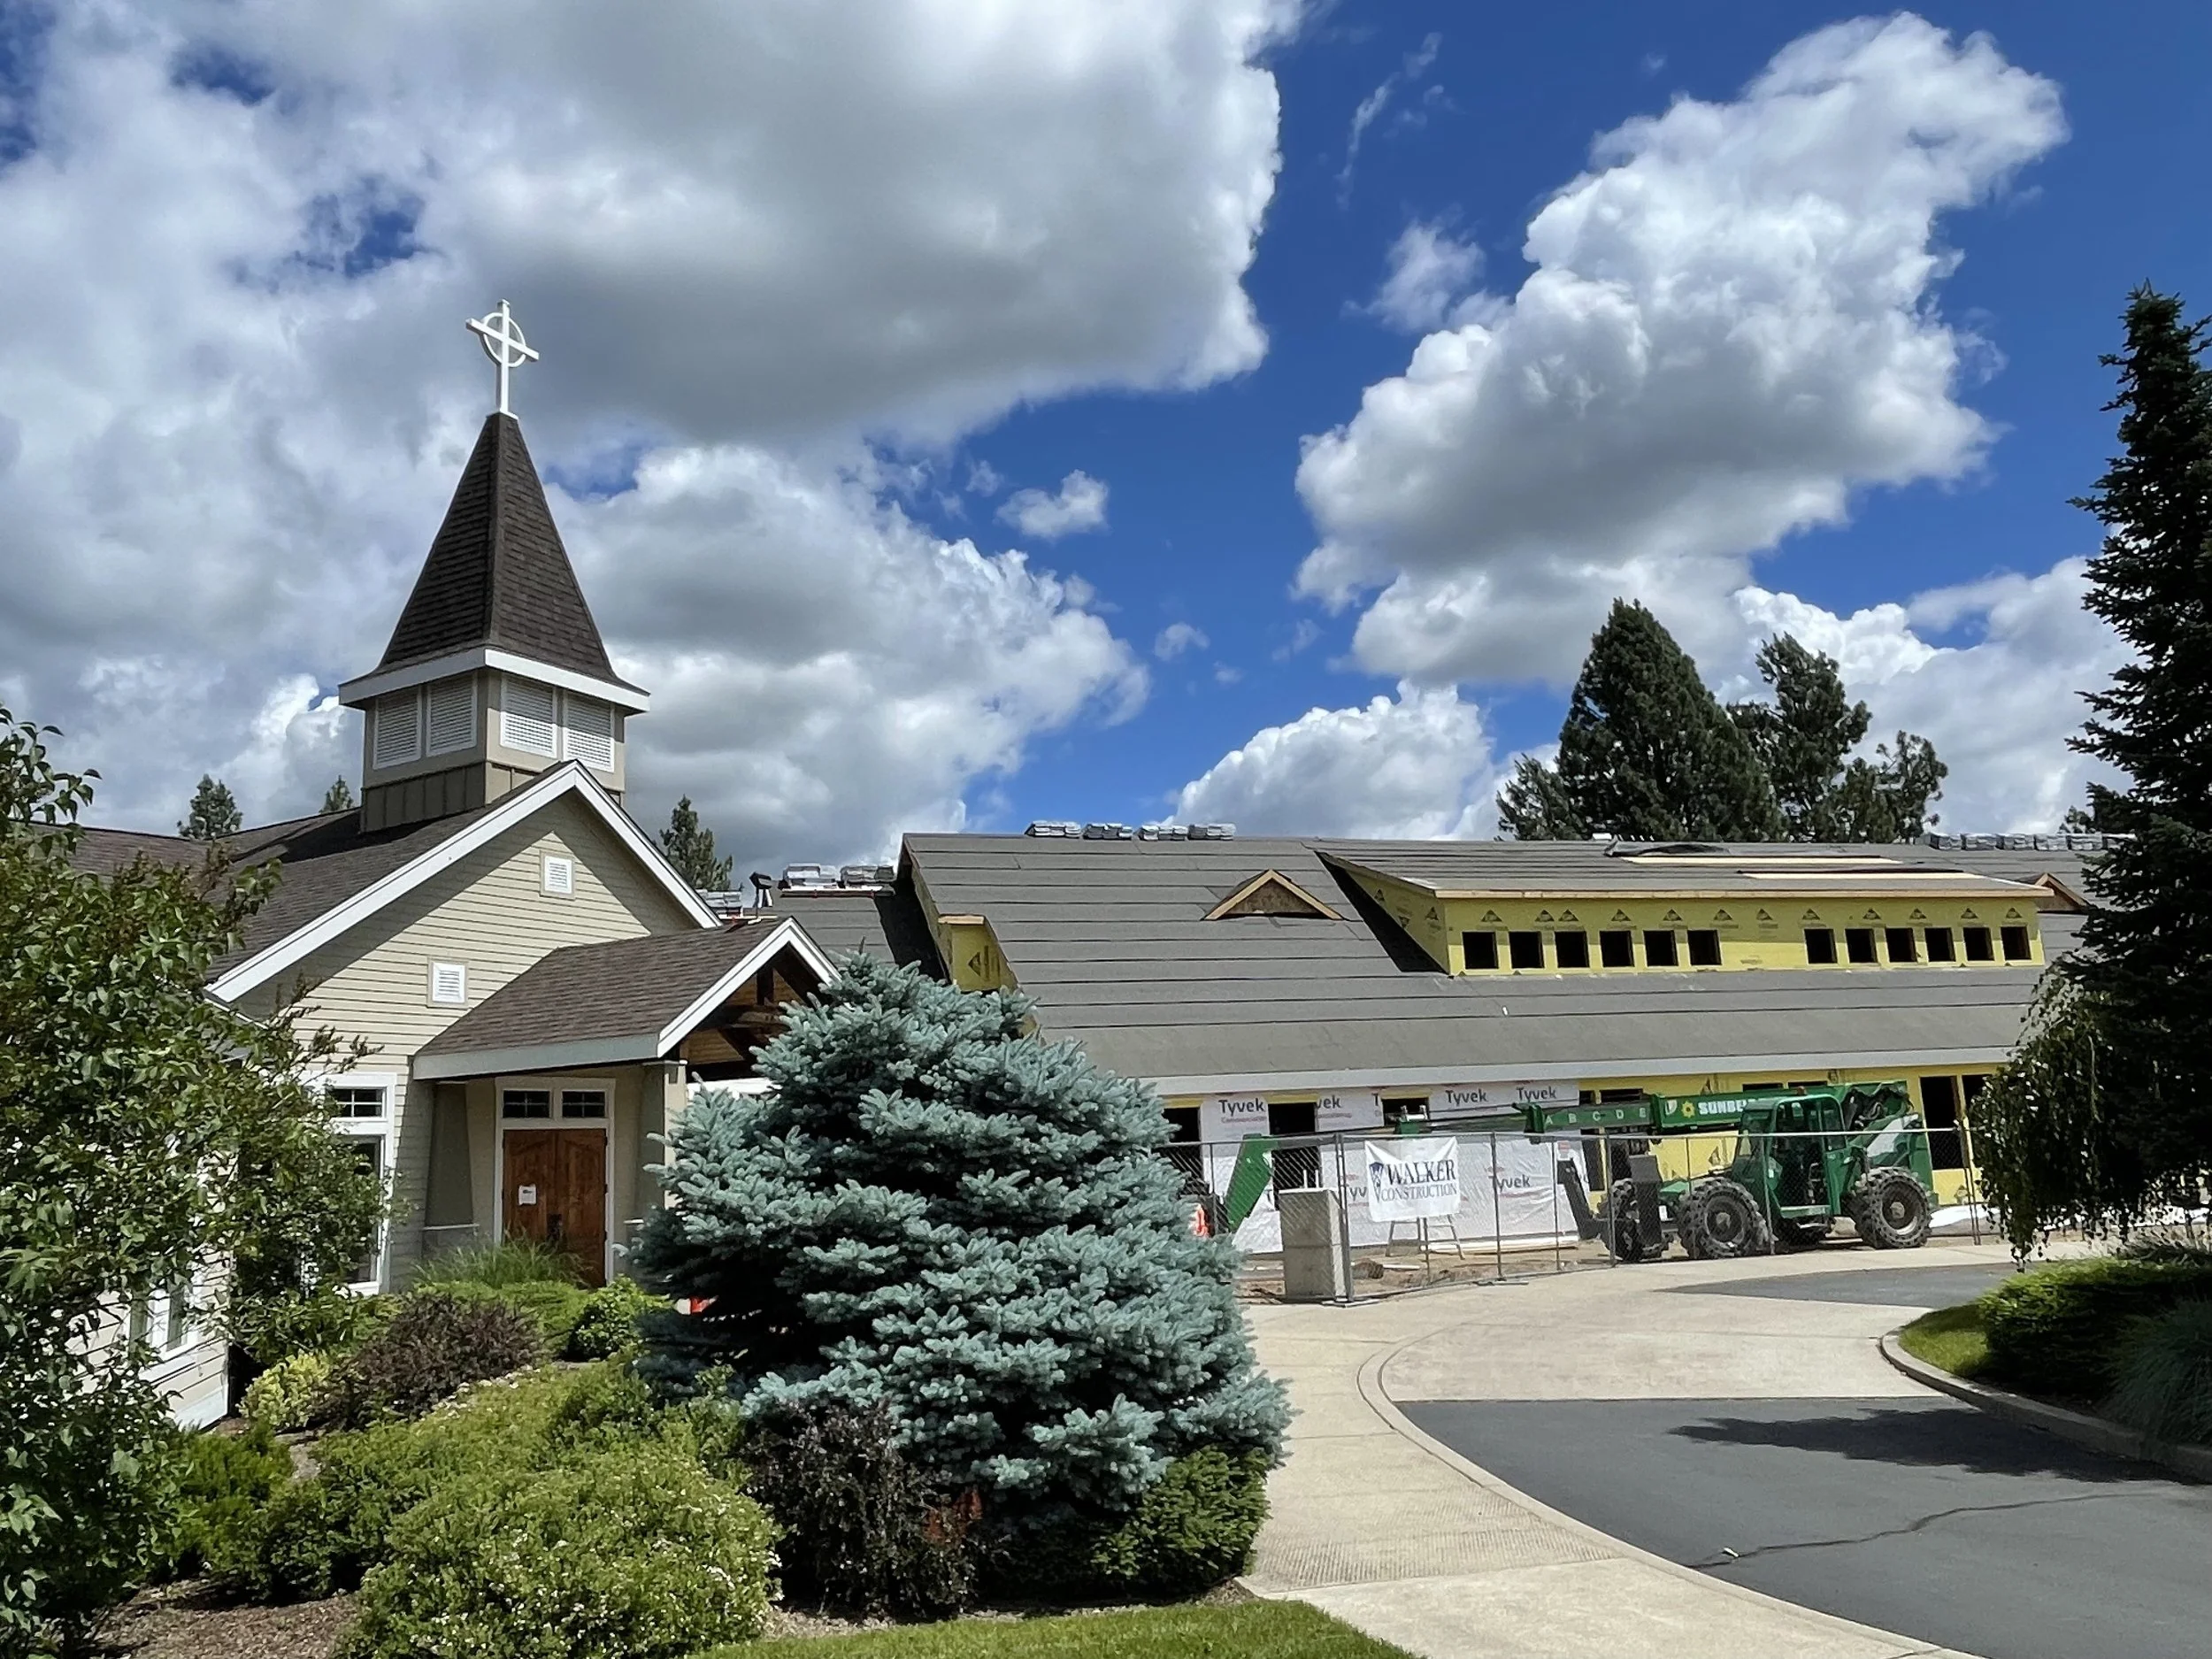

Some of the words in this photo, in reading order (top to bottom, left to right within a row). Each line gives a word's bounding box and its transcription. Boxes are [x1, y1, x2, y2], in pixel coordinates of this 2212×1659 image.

[1445, 1088, 1487, 1105] Tyvek
[1517, 1086, 1557, 1102] Tyvek
[1218, 1098, 1265, 1117] Tyvek
[1545, 1115, 1554, 1125] A
[1568, 1113, 1577, 1124] B
[1616, 1110, 1624, 1119] D
[1386, 1159, 1456, 1185] WALKER
[1381, 1182, 1458, 1202] CONSTRUCTION
